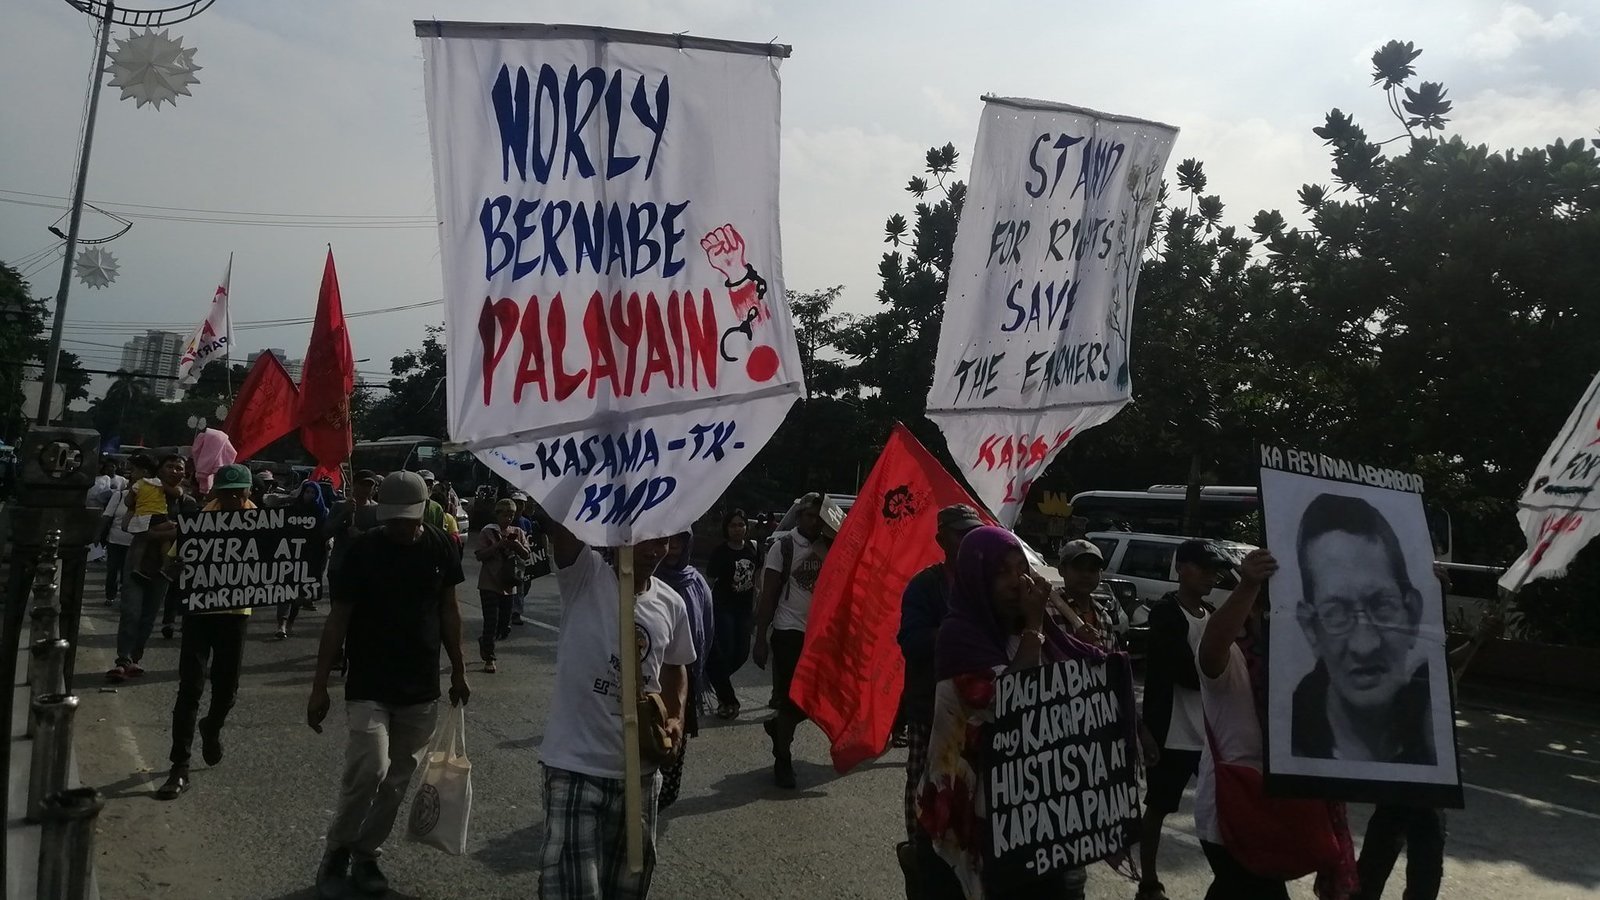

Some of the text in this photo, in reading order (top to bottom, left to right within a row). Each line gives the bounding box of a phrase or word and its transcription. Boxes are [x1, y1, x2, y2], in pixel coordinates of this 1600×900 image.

[491, 62, 670, 184] NORLY
[1025, 133, 1125, 200] STAND
[479, 195, 691, 282] BERNABE
[986, 219, 1031, 269] FOR
[1001, 279, 1081, 333] SAVE
[478, 288, 718, 406] PALAYAIN
[953, 342, 1110, 405] THE FARMERS
[1260, 443, 1283, 470] KA
[1287, 449, 1318, 476] REY
[177, 508, 285, 535] WAKASAN
[575, 475, 677, 527] KMP
[179, 560, 317, 590] PANUNUPIL
[180, 537, 307, 563] GYERA AT
[995, 658, 1107, 719] IPAGLABAN
[1021, 690, 1120, 754] KARAPATAN
[991, 737, 1127, 809] HUSTISYA AT
[991, 781, 1138, 858] KAPAYAPAAN!
